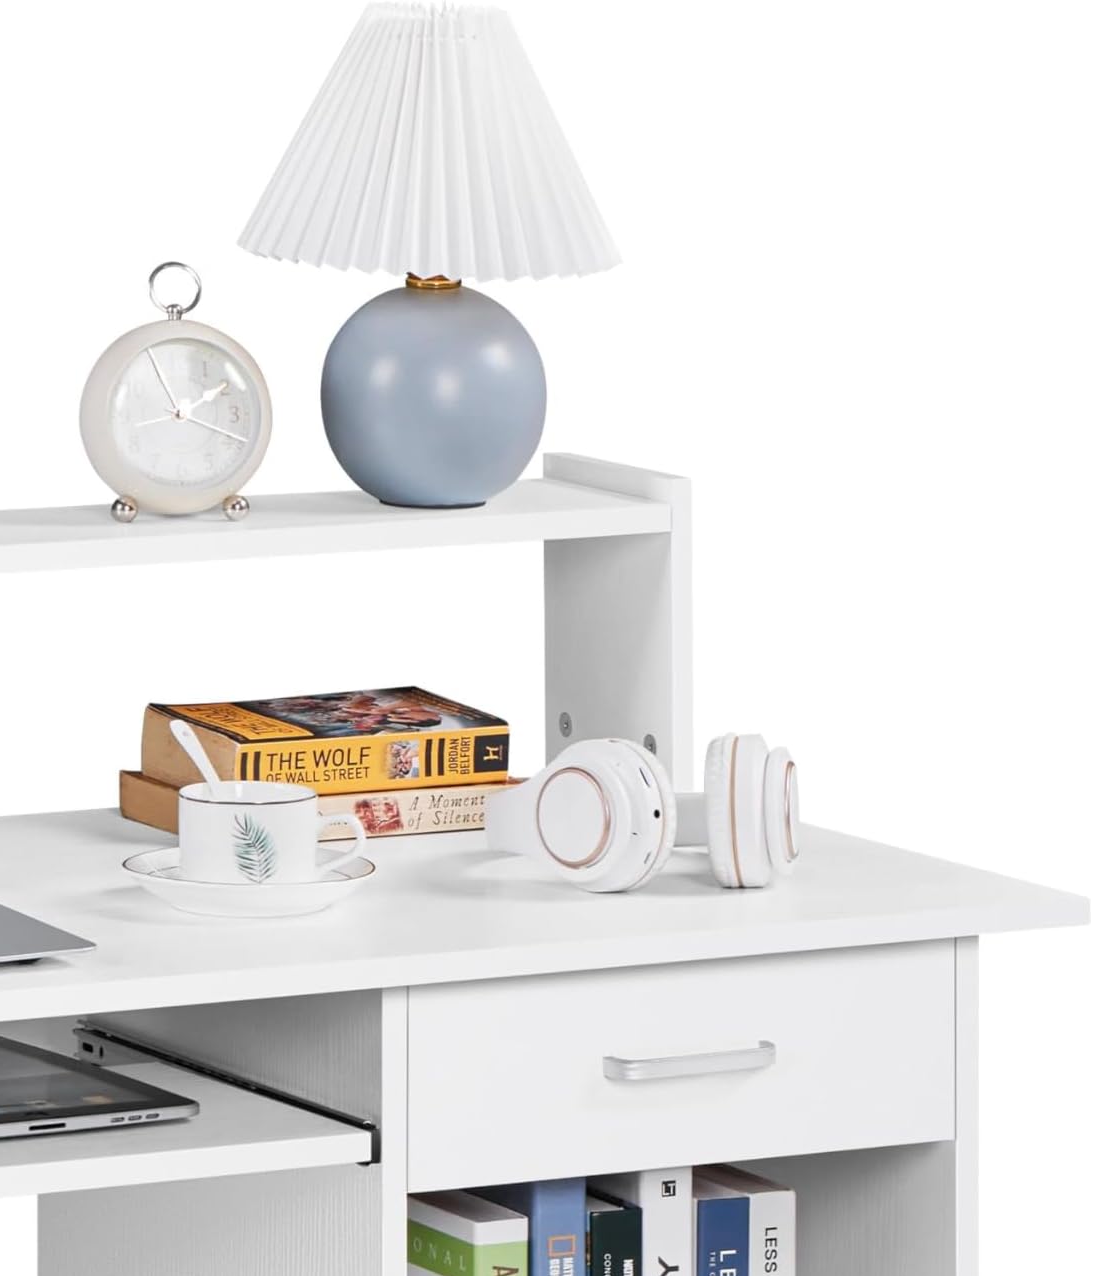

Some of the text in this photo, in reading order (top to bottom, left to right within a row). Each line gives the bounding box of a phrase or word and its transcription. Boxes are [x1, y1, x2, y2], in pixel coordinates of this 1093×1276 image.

[229, 405, 241, 423] 3
[267, 747, 371, 772] THE WOLF
[448, 738, 460, 774] JORDAN
[460, 736, 471, 775] BELFORT
[285, 771, 320, 783] WALL
[323, 766, 370, 782] STREET
[409, 794, 485, 811] A Moment
[408, 810, 485, 829] of Silence
[708, 1251, 717, 1267] THE
[763, 1226, 778, 1274] LESS
